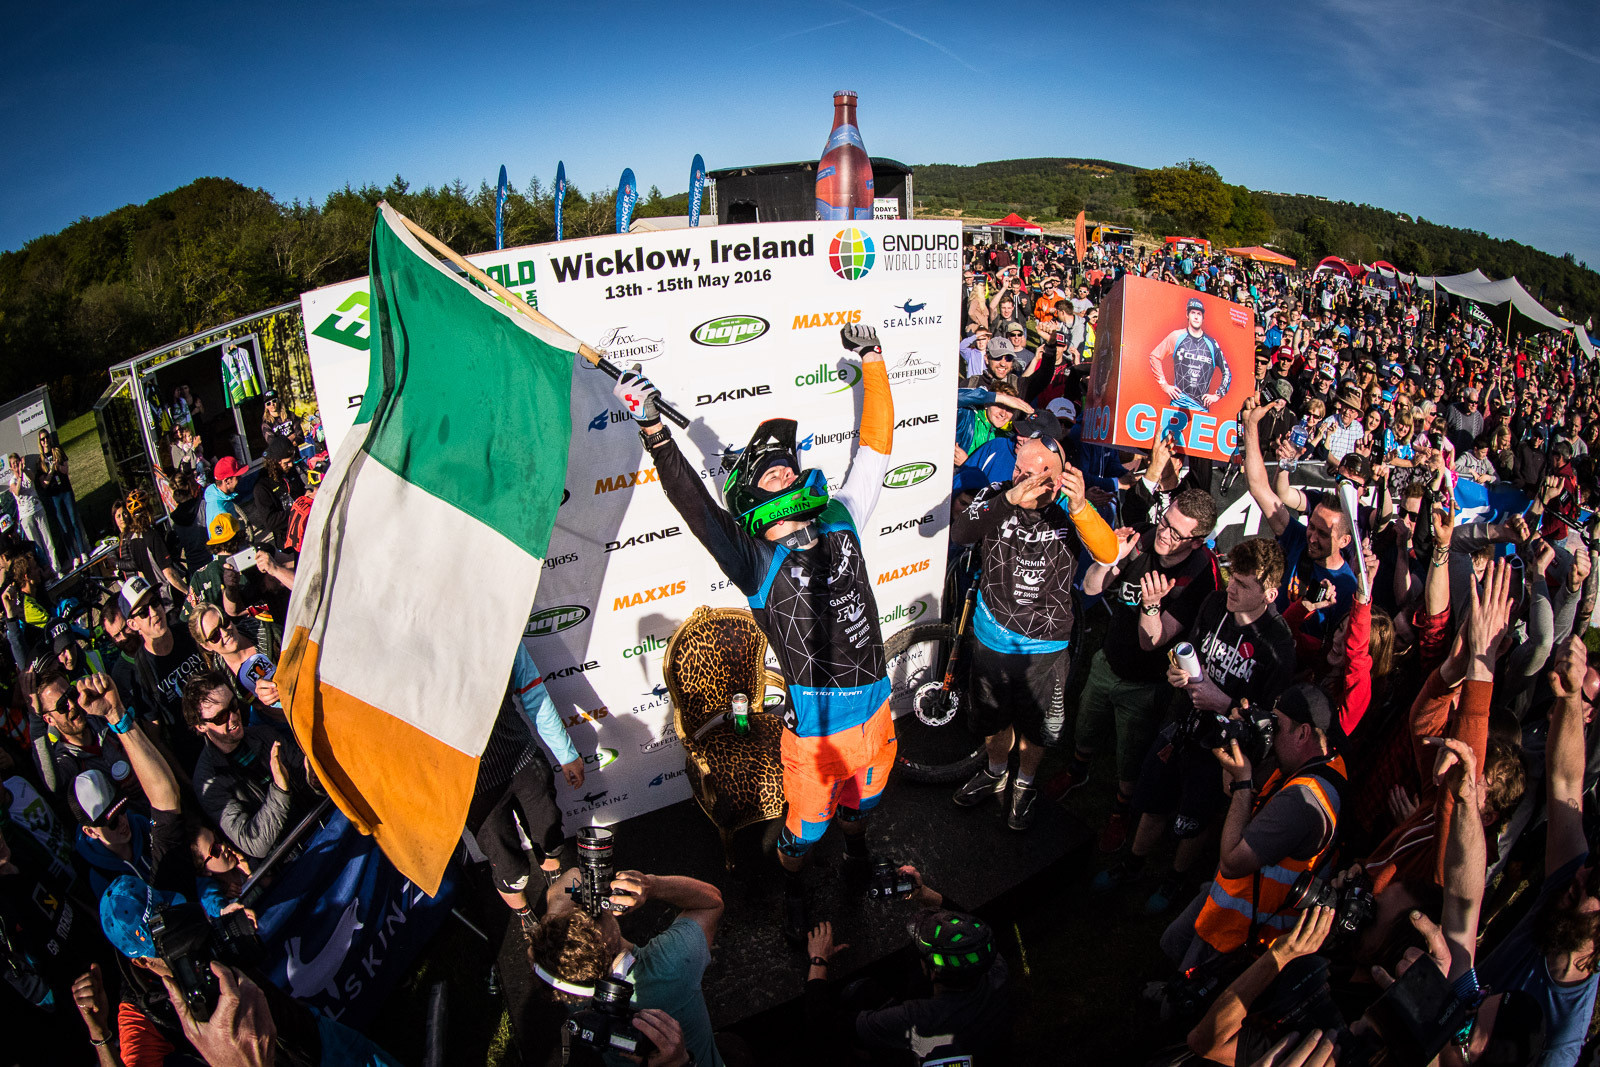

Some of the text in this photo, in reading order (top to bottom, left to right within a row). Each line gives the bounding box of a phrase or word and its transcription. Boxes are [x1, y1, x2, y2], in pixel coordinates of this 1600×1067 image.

[621, 195, 630, 234] DINGER
[550, 233, 814, 283] Wicklow, Ireland
[884, 252, 958, 271] WORLD SERIES
[605, 283, 643, 300] 13th
[657, 277, 693, 293] 15th
[698, 274, 730, 288] May
[734, 269, 772, 284] 2016
[792, 310, 862, 330] MAXXIS
[883, 315, 942, 329] SEALSKINZ
[699, 321, 764, 344] hope
[602, 344, 659, 360] FEEHOUSE
[1184, 352, 1212, 364] CUBE
[887, 367, 937, 380] COFFEEHOUSE
[695, 384, 773, 406] DAKINE
[21, 410, 44, 425] RACE OFFICE
[893, 414, 939, 429] AKINE
[1083, 404, 1111, 440] NICO
[814, 428, 860, 445] bluegrass
[1126, 404, 1238, 456] GREG
[887, 466, 932, 486] hope
[769, 501, 810, 520] GARMIN
[880, 515, 934, 536] DAKINE
[1016, 528, 1068, 543] CUBE
[604, 526, 682, 553] DAKINE
[1016, 556, 1046, 567] GARMIN
[877, 559, 930, 585] MAXXIS
[613, 580, 687, 611] MAXXIS
[157, 653, 202, 693] VICTORY
[543, 660, 601, 683] AKINE
[838, 689, 863, 697] TEAM
[633, 696, 669, 714] SEALS
[566, 793, 629, 817] SEALSKINZ
